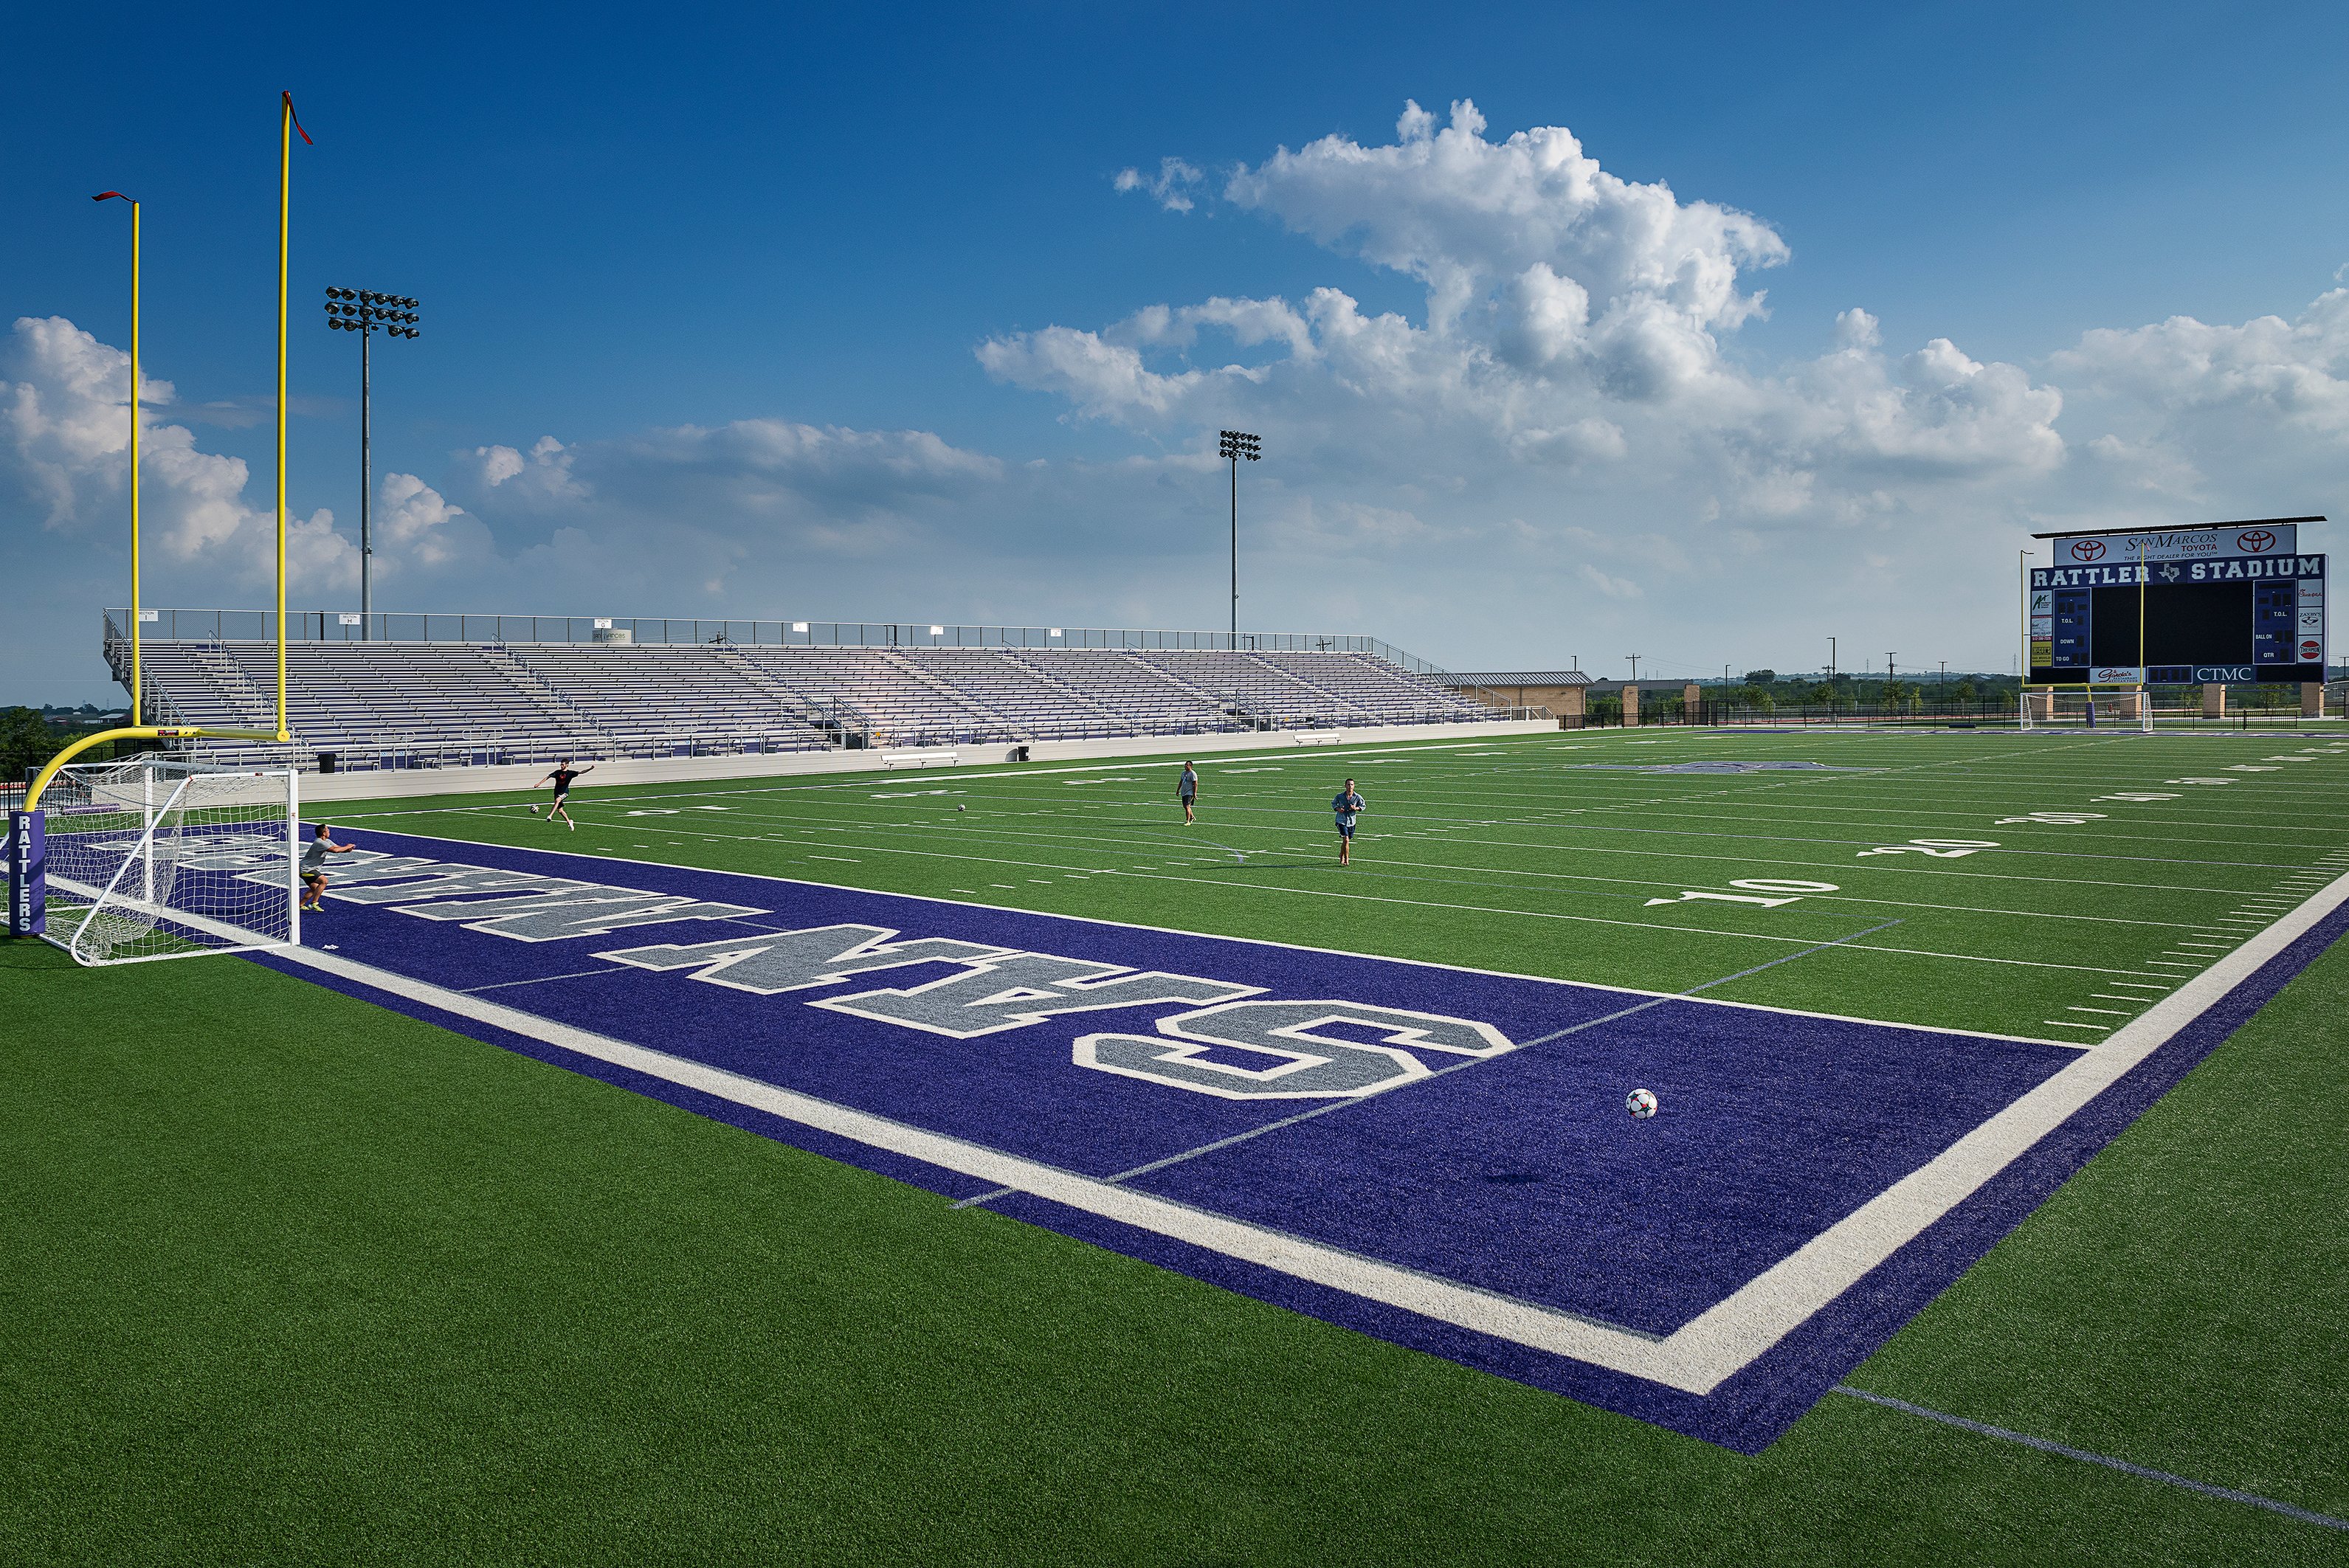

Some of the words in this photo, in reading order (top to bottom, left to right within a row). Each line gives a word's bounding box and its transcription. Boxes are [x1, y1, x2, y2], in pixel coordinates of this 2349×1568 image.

[2125, 538, 2155, 551] SAN
[2155, 534, 2218, 548] MARCOS
[2181, 544, 2218, 552] TOYOTA
[2034, 566, 2150, 587] RATTLER
[2191, 557, 2320, 580] STADIUM
[2098, 669, 2132, 683] Garcia's
[2197, 668, 2252, 682] CTMC
[1871, 839, 2001, 858] 20
[18, 815, 30, 932] RATTLERS
[1677, 879, 1841, 908] 10
[590, 923, 1517, 1102] SAN
